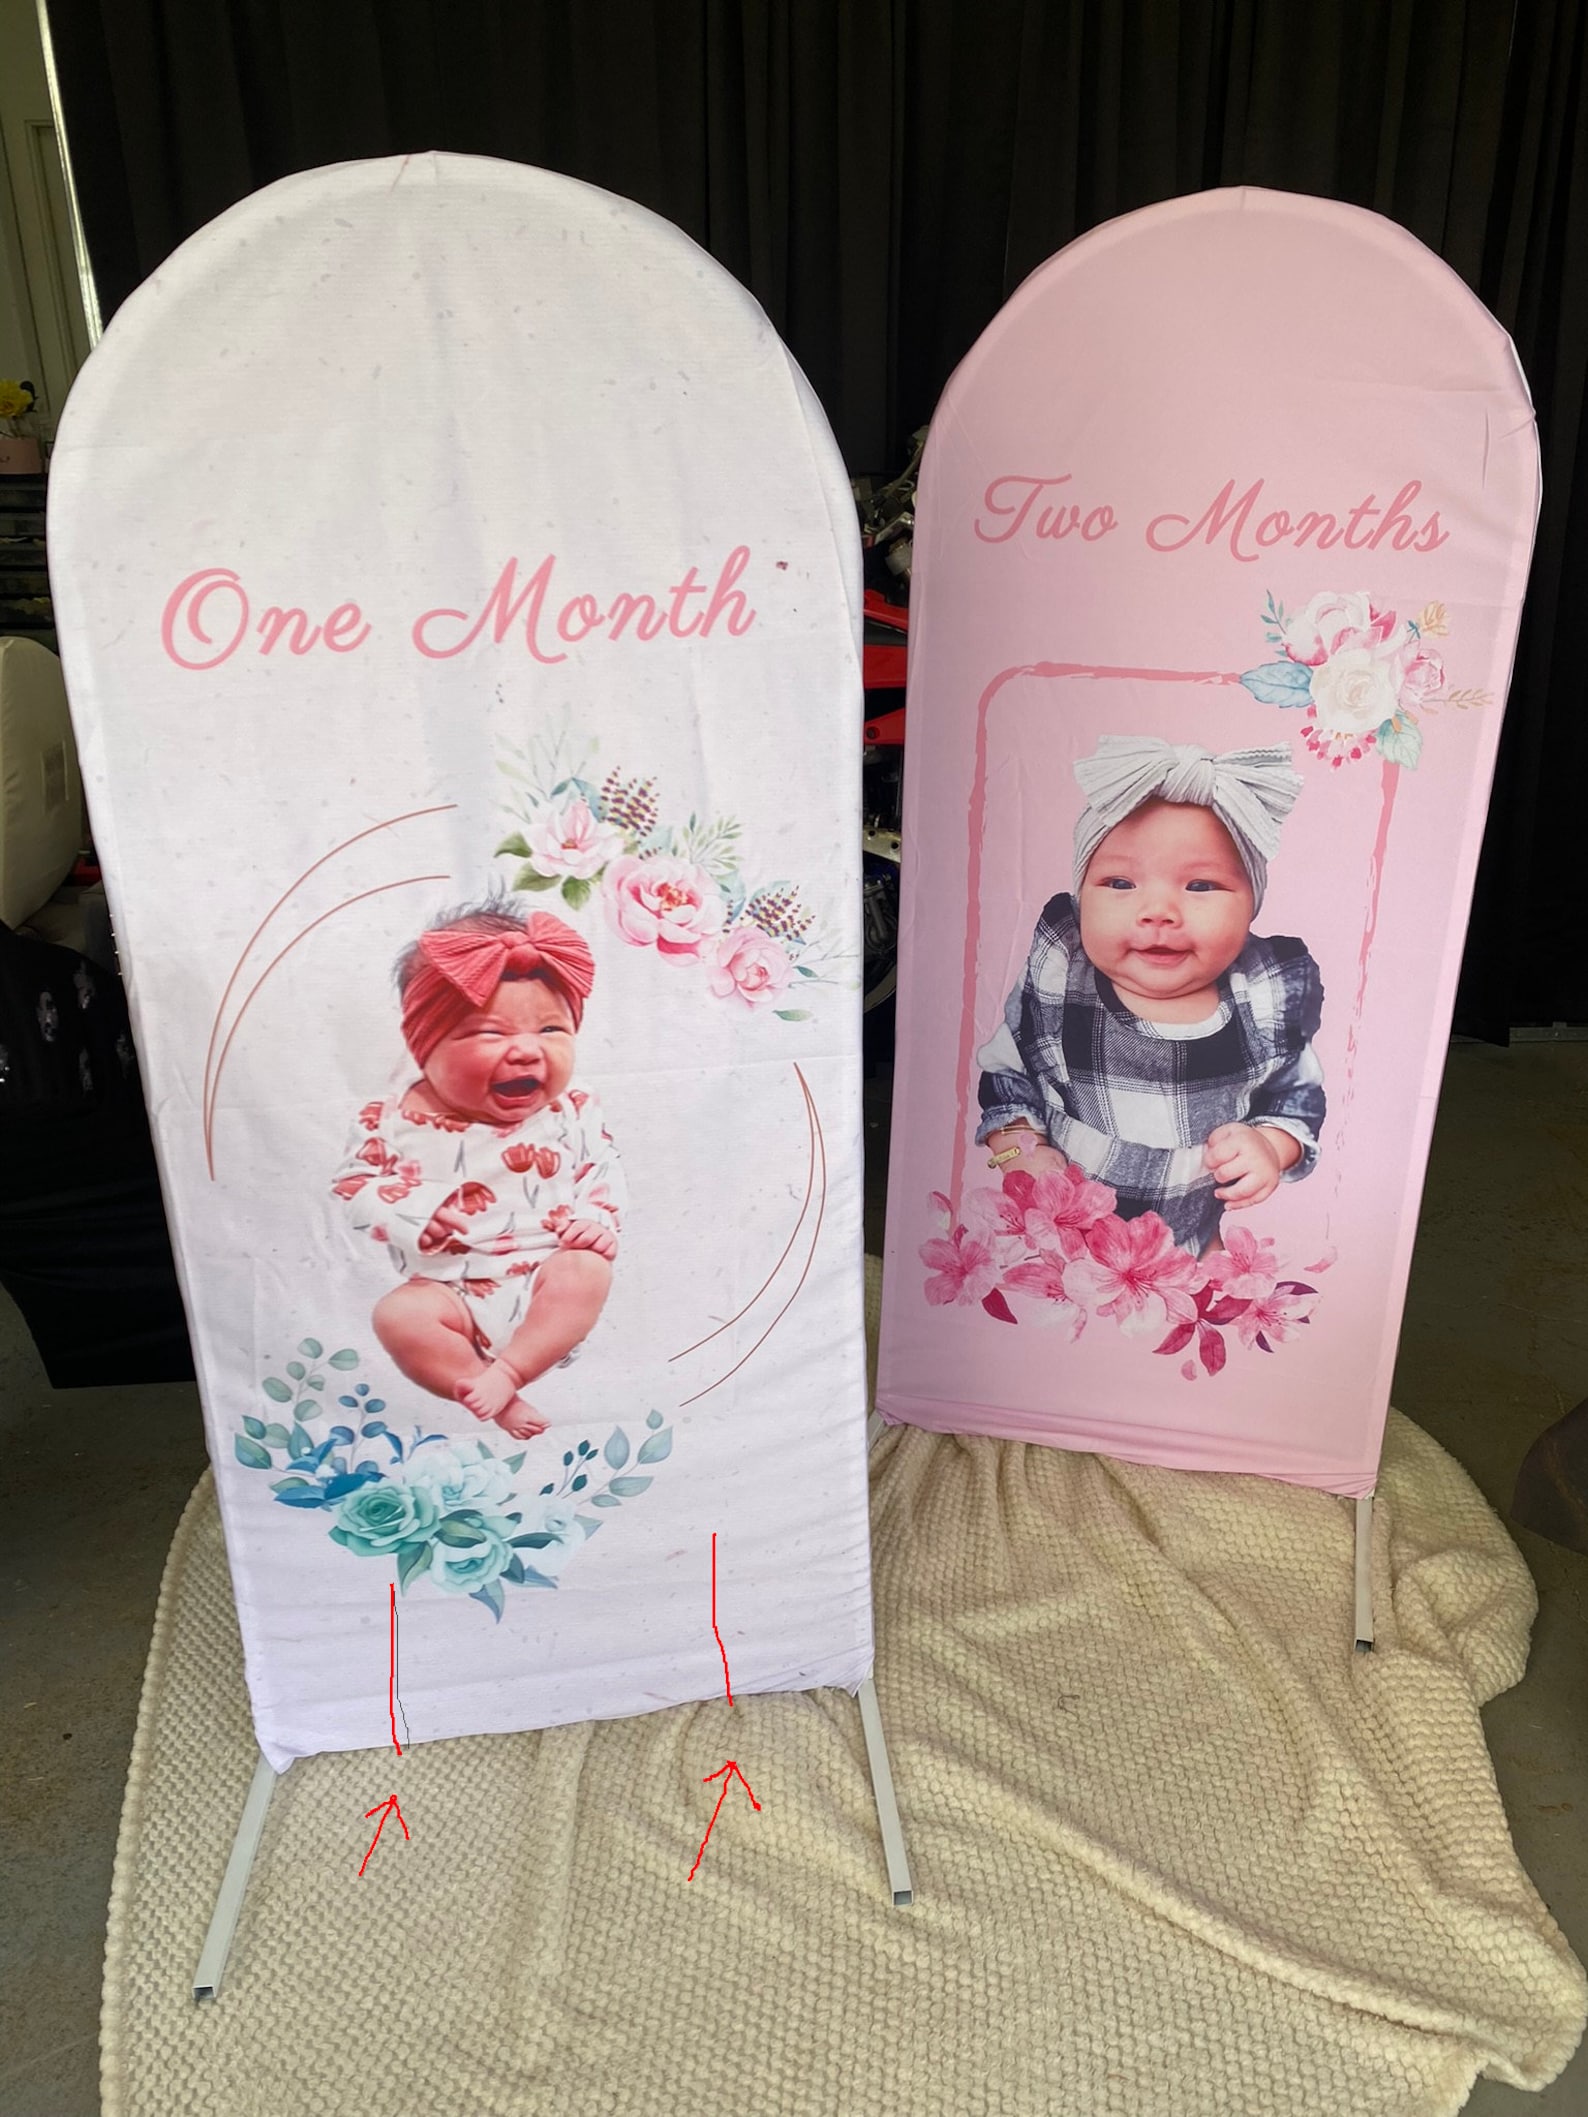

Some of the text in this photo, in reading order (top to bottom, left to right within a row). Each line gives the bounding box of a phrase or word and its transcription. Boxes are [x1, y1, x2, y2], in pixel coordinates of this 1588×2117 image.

[974, 473, 1450, 562] Two Months
[161, 545, 757, 671] One Month
